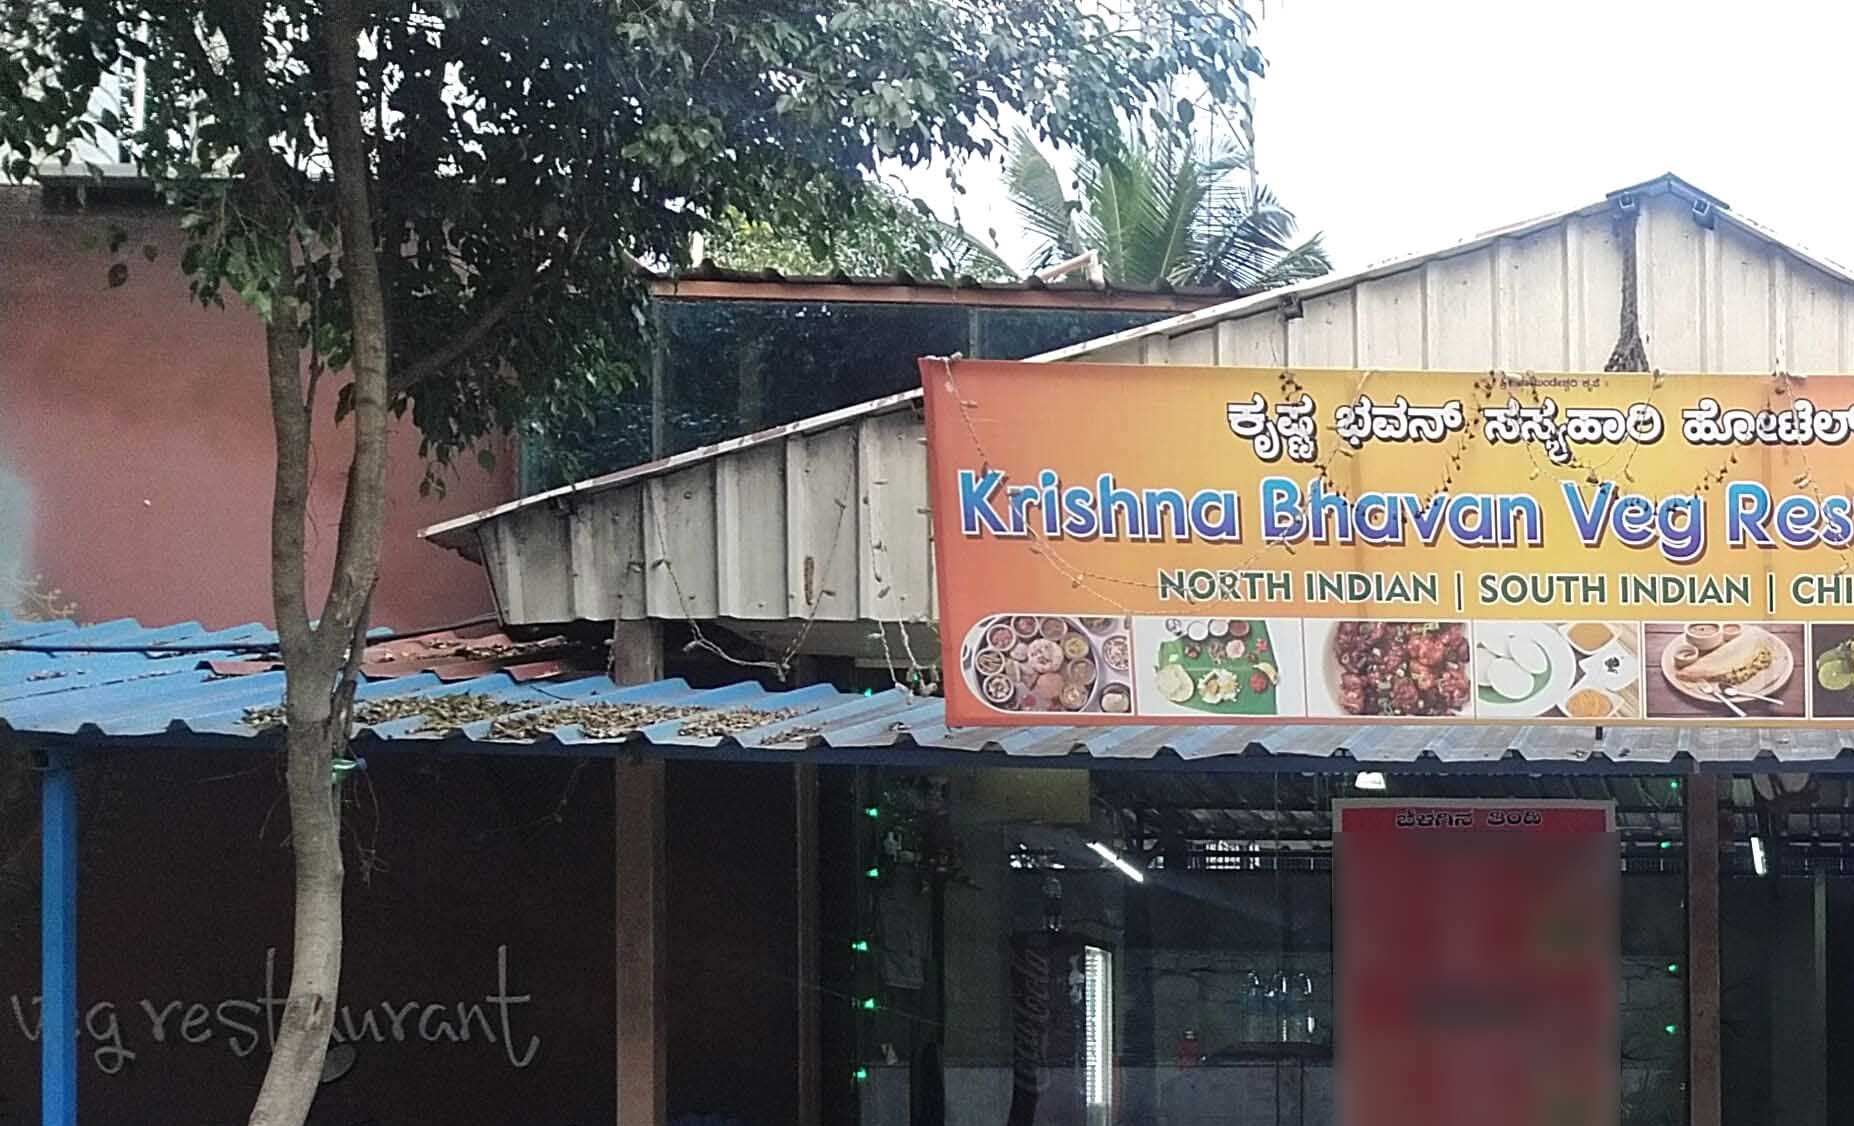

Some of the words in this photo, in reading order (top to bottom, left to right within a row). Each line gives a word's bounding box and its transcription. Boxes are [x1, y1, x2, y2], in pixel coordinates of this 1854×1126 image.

[1227, 391, 1316, 462] ಕೃಷ್ಣ
[1335, 393, 1466, 449] ಭವನ್
[957, 468, 1241, 542] Krishna
[1259, 477, 1543, 546] Bhavan
[1560, 480, 1705, 562] Veg
[1158, 568, 1293, 603] NORTH
[1305, 573, 1437, 603] INDIAN
[1480, 573, 1606, 606] SOUTH
[1619, 575, 1751, 605] INDIAN
[11, 993, 135, 1074] vg
[141, 945, 540, 1069] resturant
